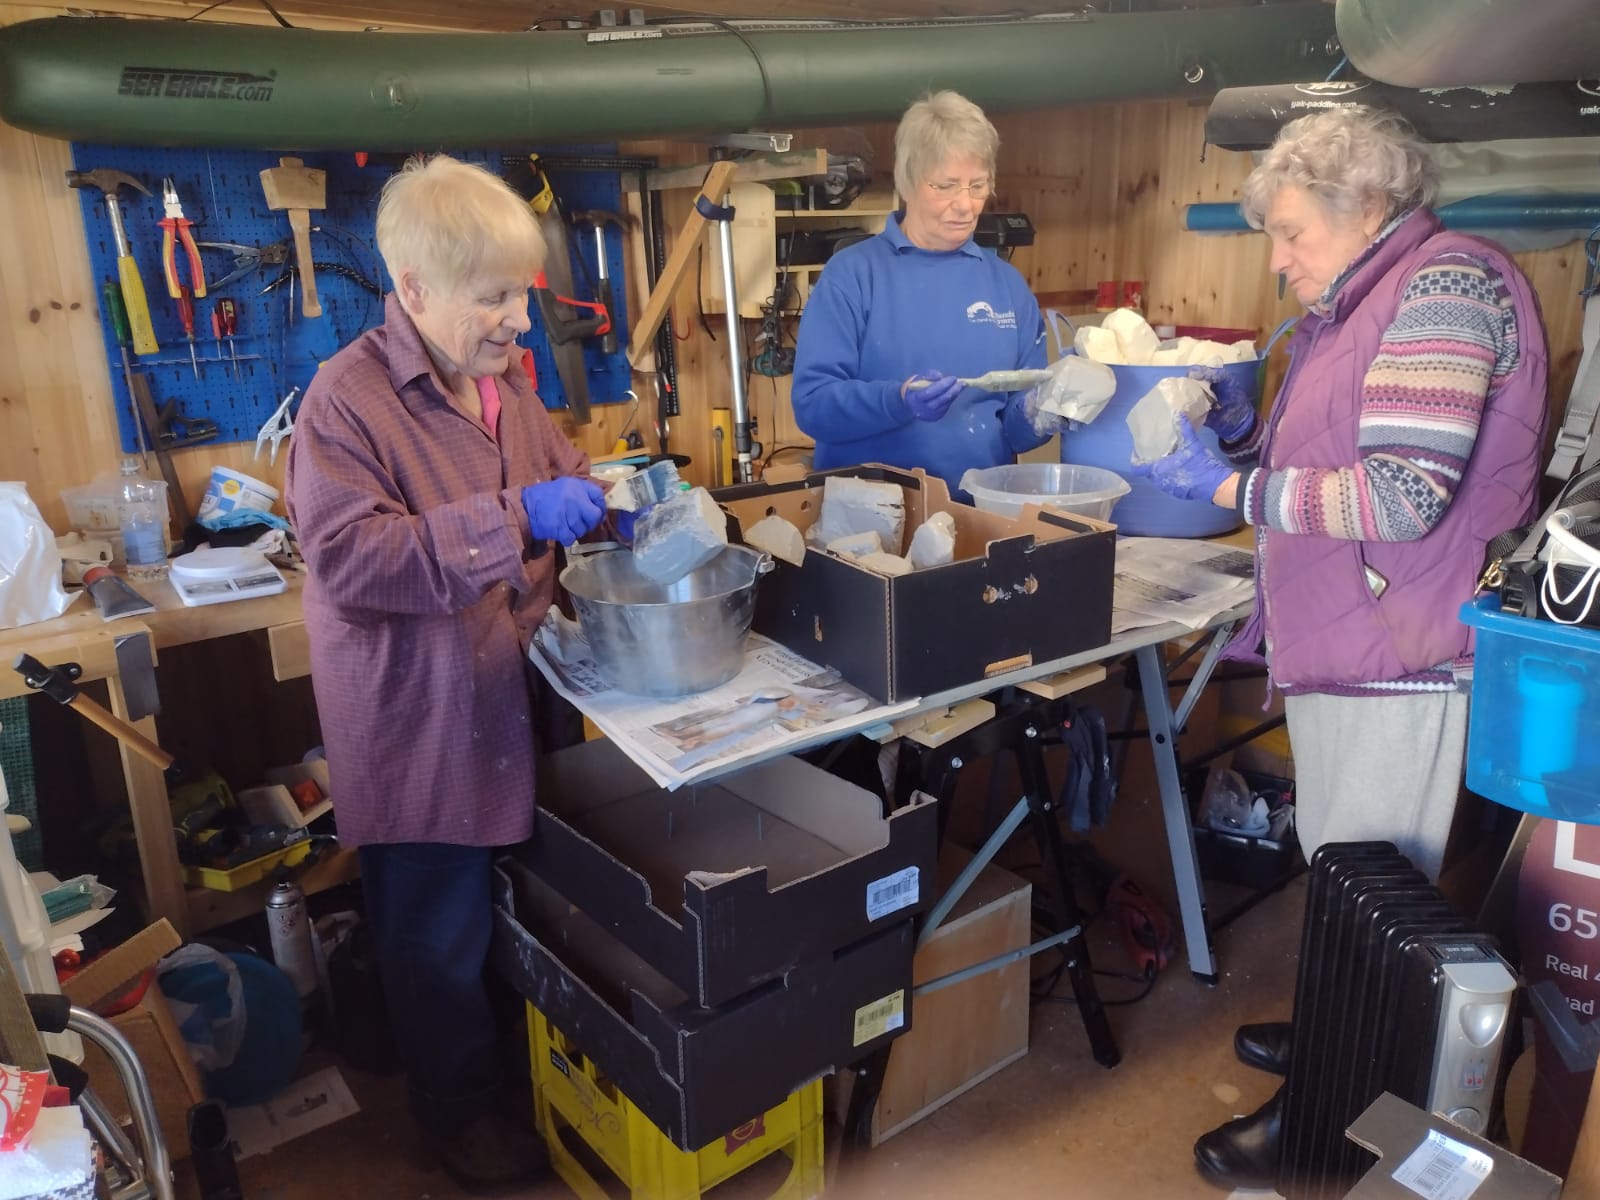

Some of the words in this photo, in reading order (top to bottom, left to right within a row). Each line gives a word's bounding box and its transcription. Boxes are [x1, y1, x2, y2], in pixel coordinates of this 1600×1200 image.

[118, 71, 164, 97] SEA
[165, 72, 274, 101] EAGLE.com
[1546, 954, 1588, 981] Real
